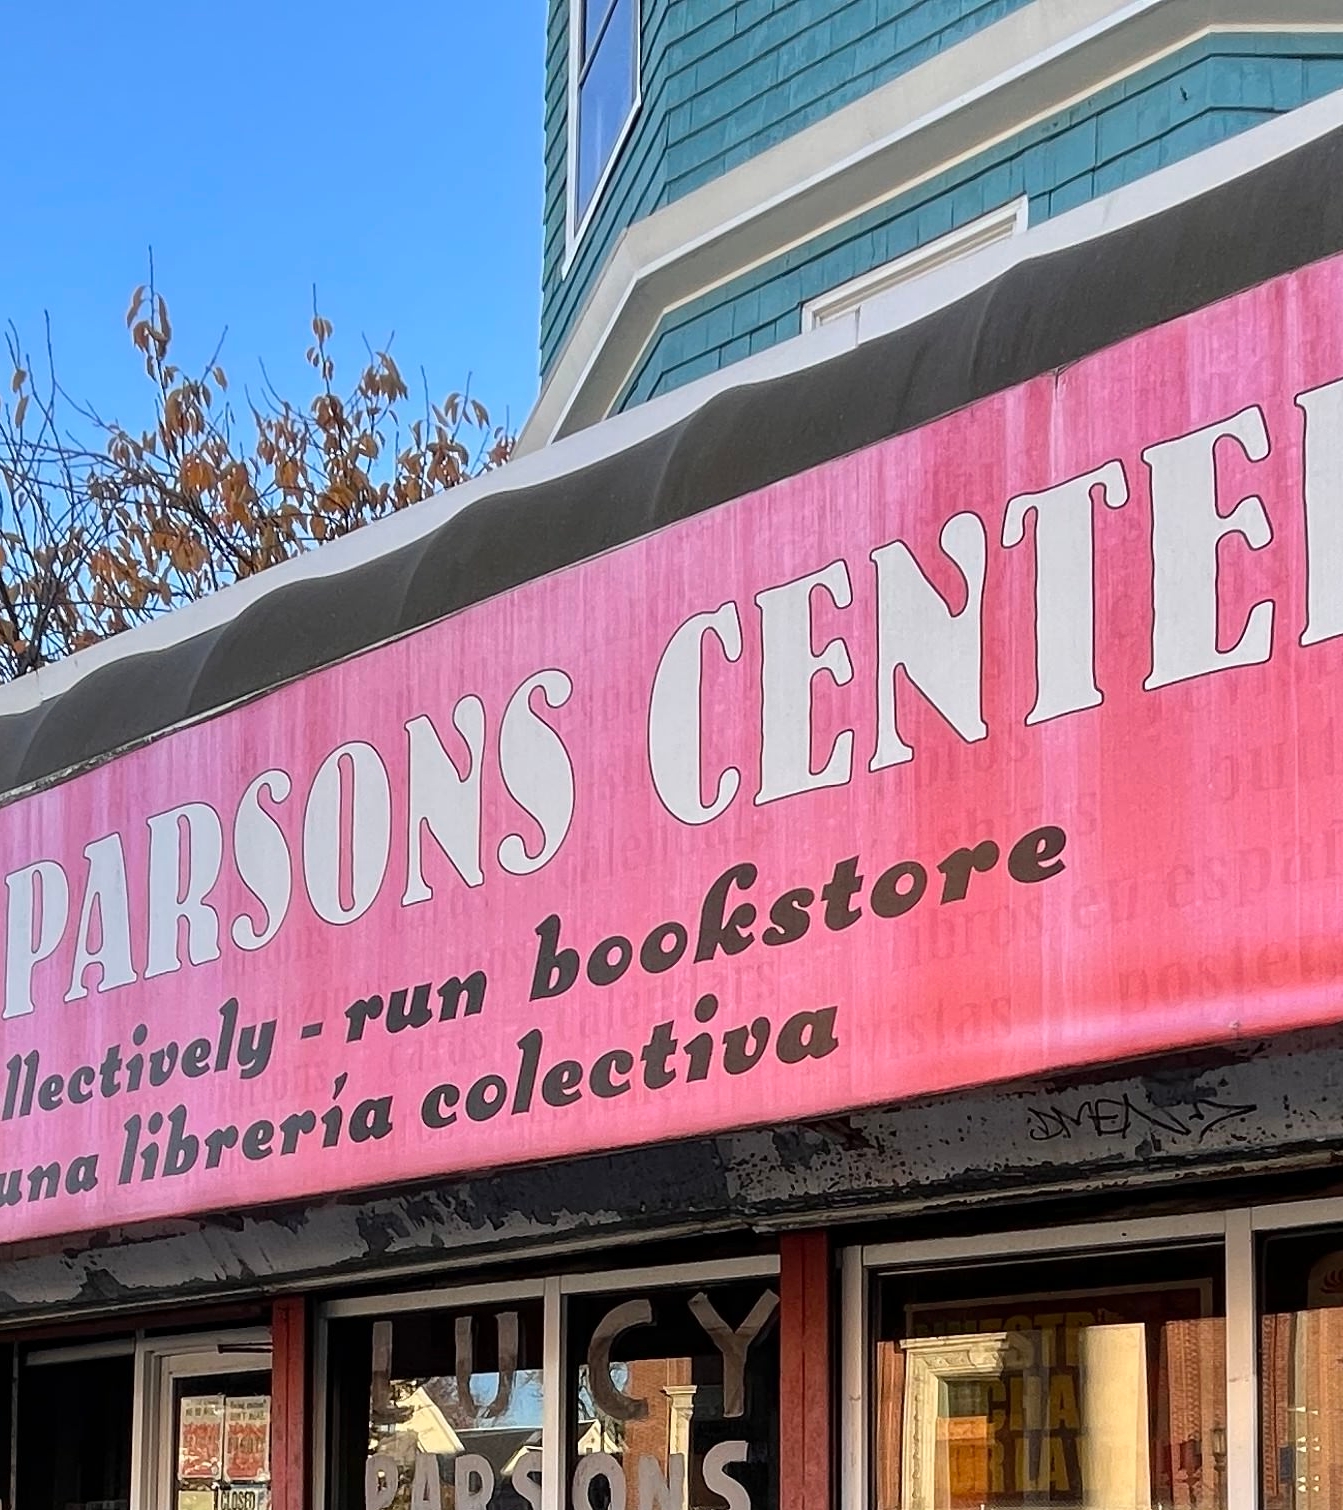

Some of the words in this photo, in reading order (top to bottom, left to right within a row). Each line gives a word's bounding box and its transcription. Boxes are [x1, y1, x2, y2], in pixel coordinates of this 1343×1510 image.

[1, 669, 575, 1020] PARSONS
[345, 983, 487, 1042] run
[530, 826, 1065, 1000] bookstore
[118, 1071, 392, 1185] librería
[421, 994, 836, 1129] colectiva
[371, 1288, 781, 1425] LUCY
[220, 1490, 256, 1510] CLOSED
